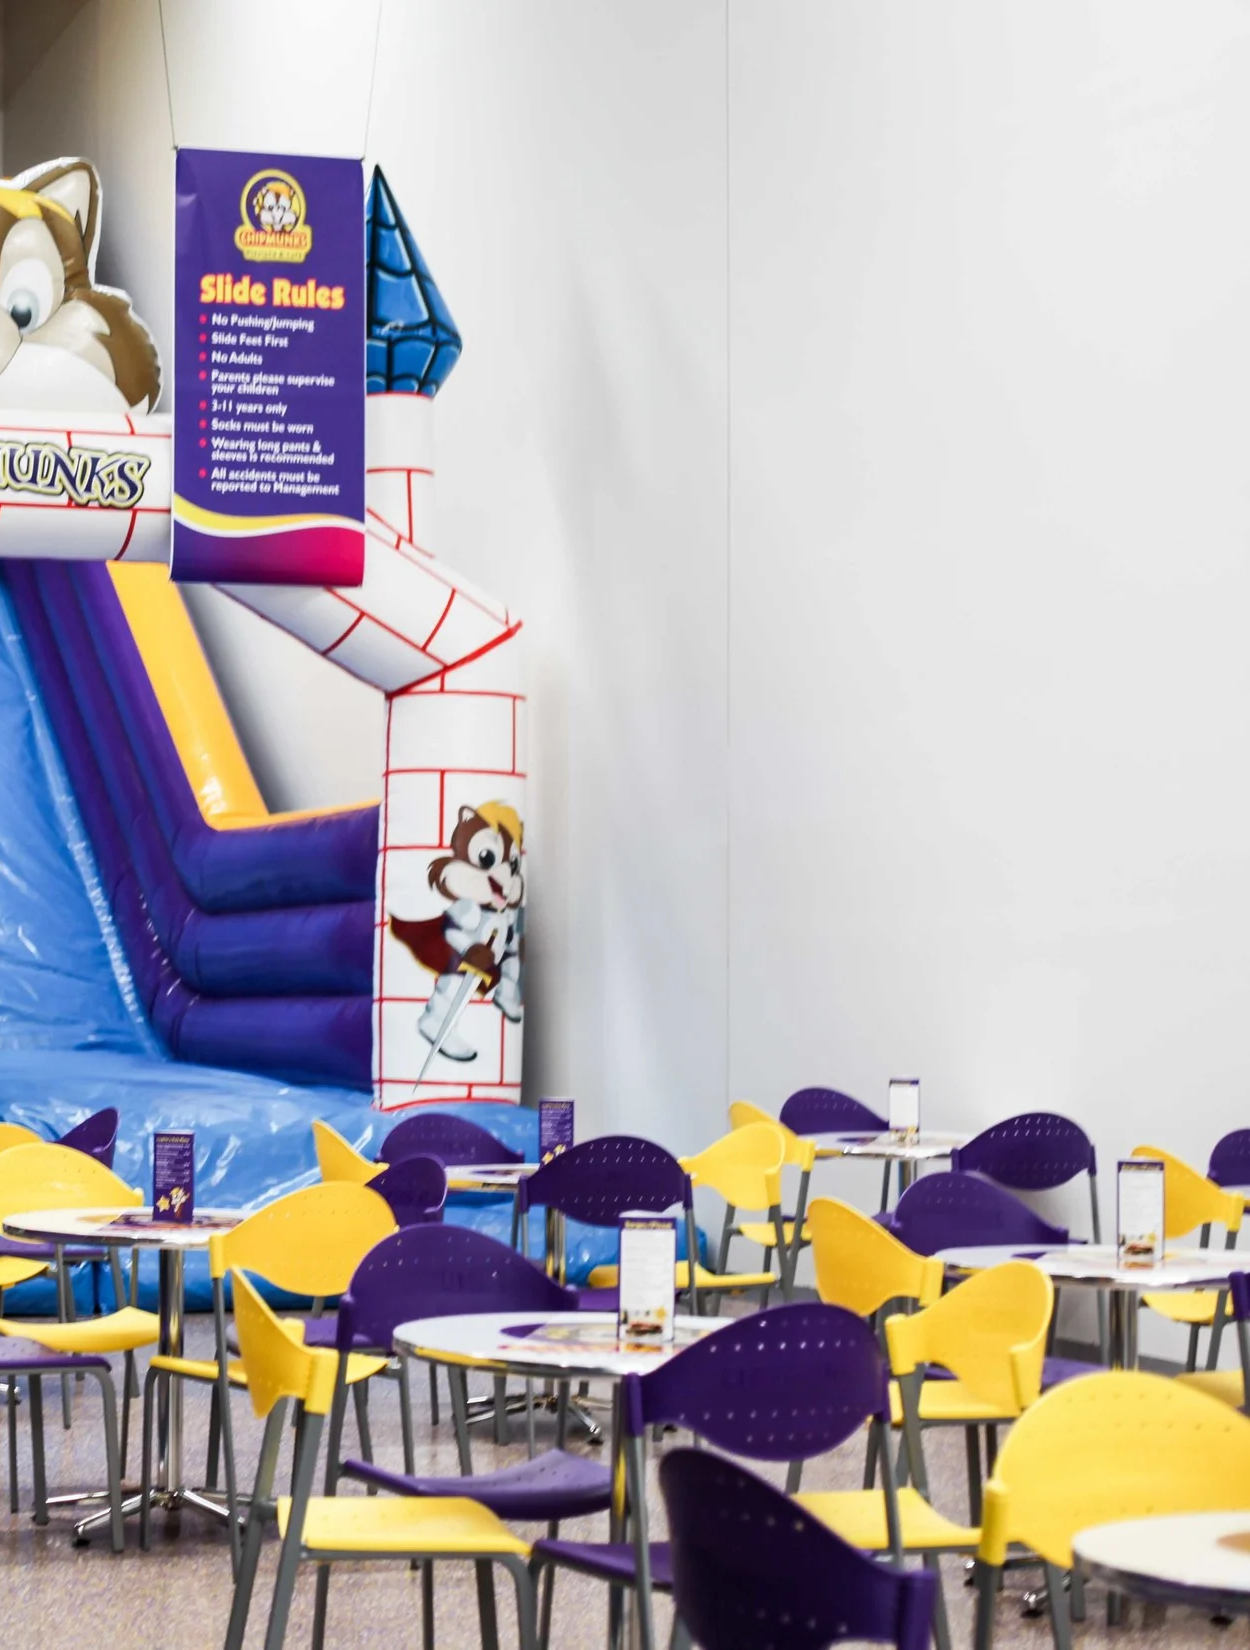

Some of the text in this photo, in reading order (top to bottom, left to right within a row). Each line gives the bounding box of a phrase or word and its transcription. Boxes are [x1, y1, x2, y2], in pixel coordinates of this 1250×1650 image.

[239, 230, 307, 249] CHIPMUNKS
[200, 272, 346, 310] Slide Rules
[211, 313, 315, 333] No Pushing/Jumping
[211, 331, 289, 348] Slide Feet First
[211, 350, 263, 365] No Adults
[211, 369, 335, 388] Parents please supervise
[211, 383, 279, 396] your children
[211, 399, 288, 417] 3-11 years only
[211, 418, 314, 435] Socks must be worn
[211, 436, 321, 454] Wearing long pants &
[211, 449, 334, 465] sleeves is recommended
[211, 467, 320, 483] All accidents must be
[211, 481, 340, 497] reported to Management
